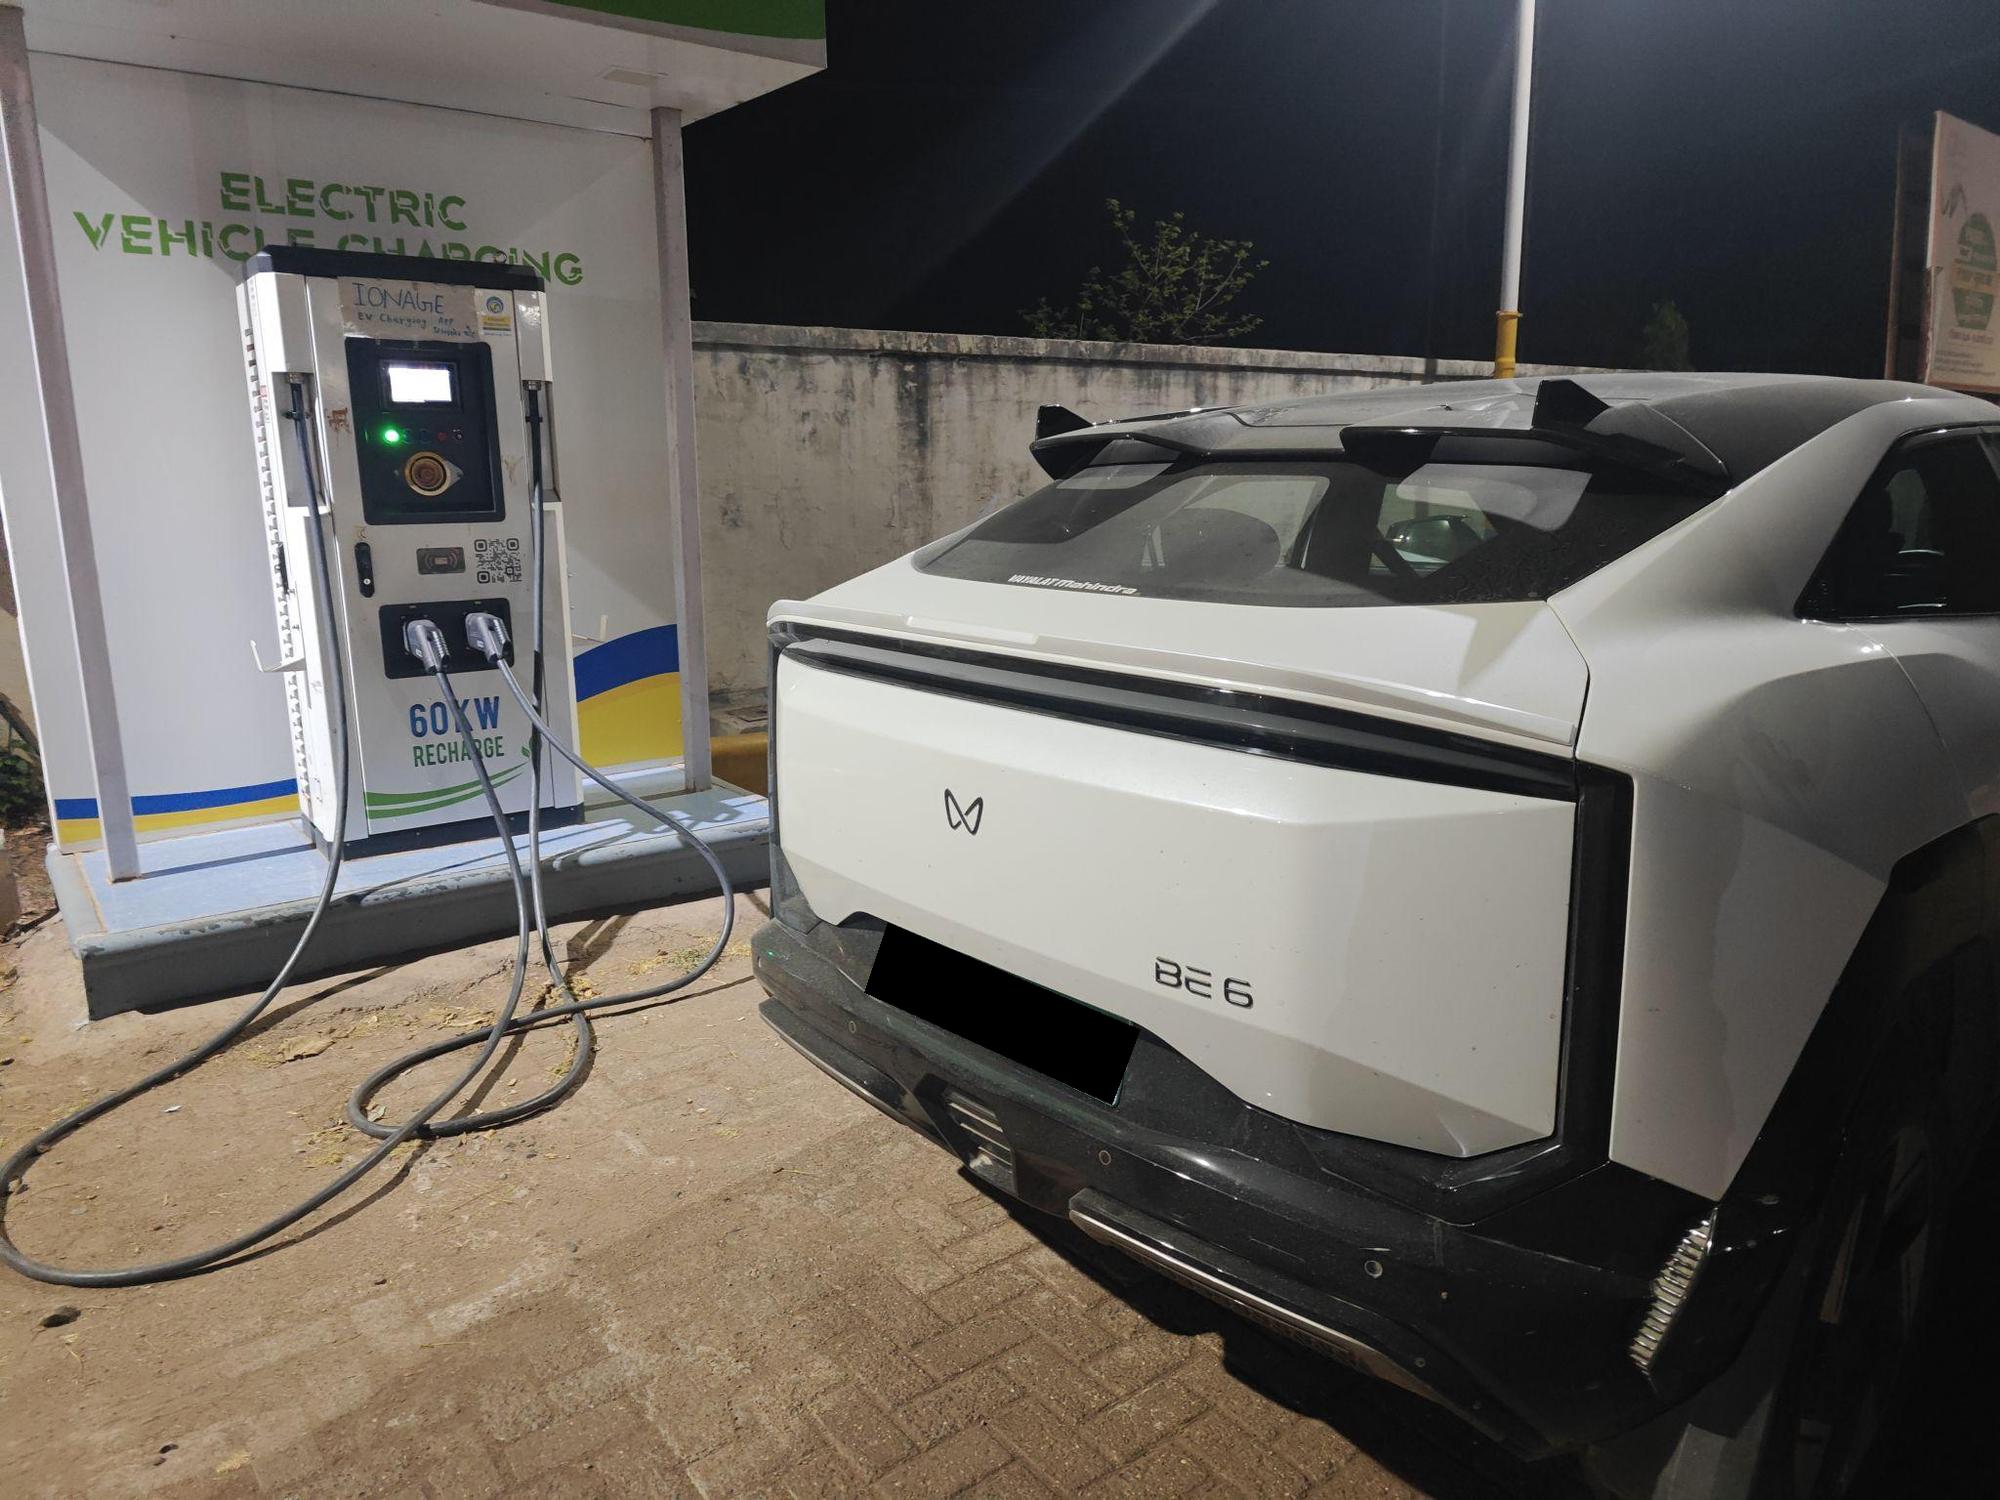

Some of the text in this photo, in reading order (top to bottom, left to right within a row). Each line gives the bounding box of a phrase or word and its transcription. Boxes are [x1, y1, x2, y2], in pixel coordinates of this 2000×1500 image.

[220, 171, 467, 231] ELECTRIC
[352, 282, 445, 314] IONAGE
[358, 312, 373, 321] EV
[1053, 579, 1138, 595] Mahindra
[412, 735, 505, 768] RECHARGE
[1155, 955, 1254, 1010] BE 6
